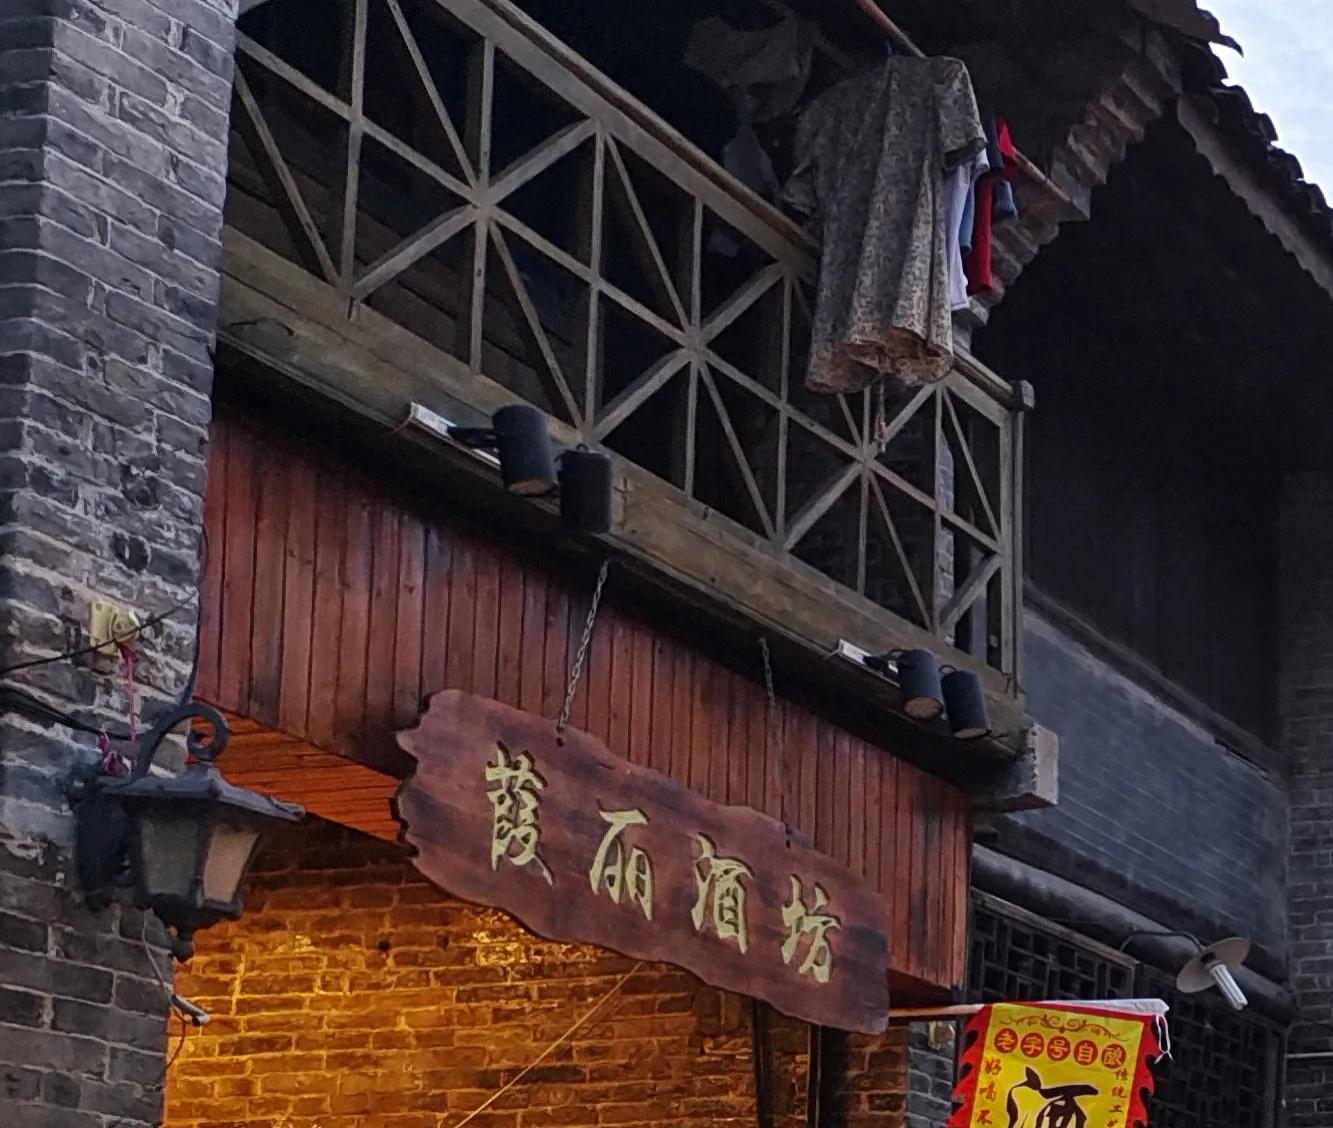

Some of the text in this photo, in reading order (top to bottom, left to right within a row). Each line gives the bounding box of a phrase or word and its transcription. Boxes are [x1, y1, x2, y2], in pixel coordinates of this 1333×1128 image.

[996, 1031, 1125, 1067] 老字号自酿
